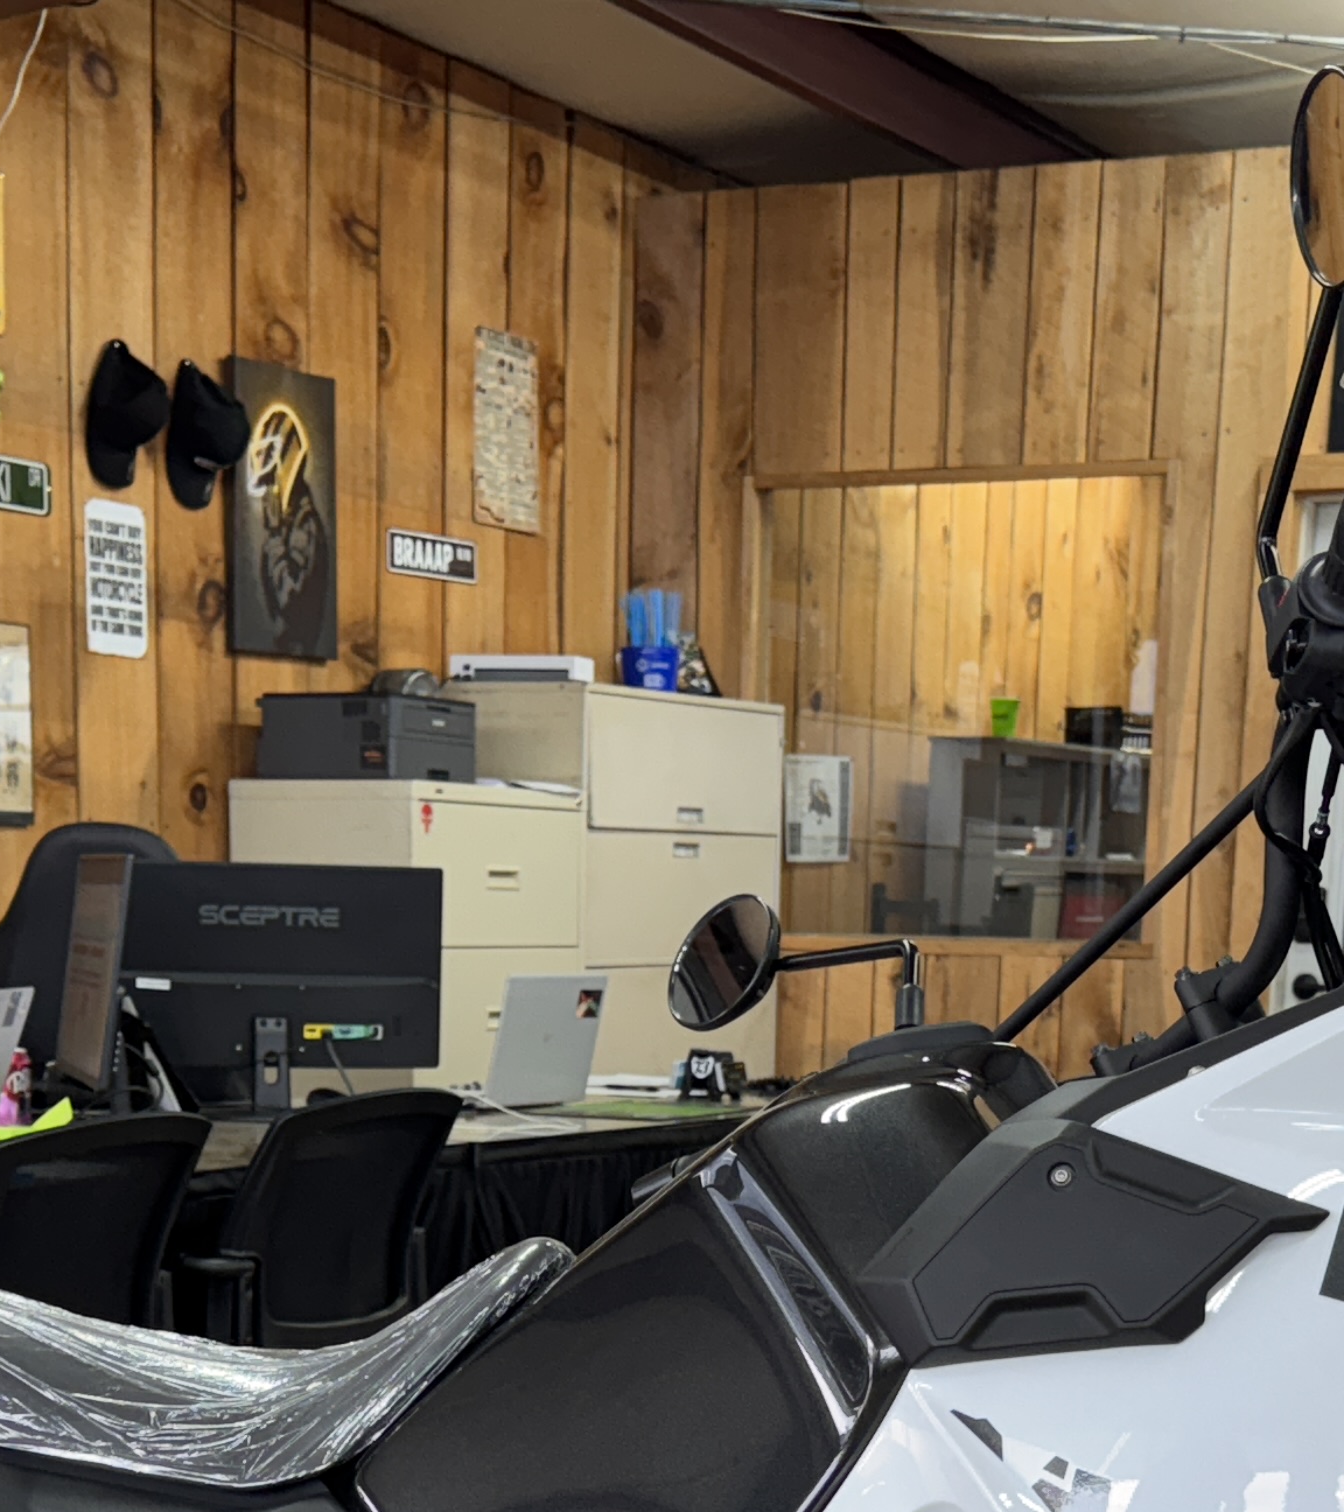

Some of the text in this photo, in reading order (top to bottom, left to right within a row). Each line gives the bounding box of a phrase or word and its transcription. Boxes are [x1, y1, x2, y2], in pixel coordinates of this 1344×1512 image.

[89, 536, 143, 565] HAPPINESS
[393, 535, 454, 573] BRAAAP
[198, 904, 340, 928] SCEPTRE
